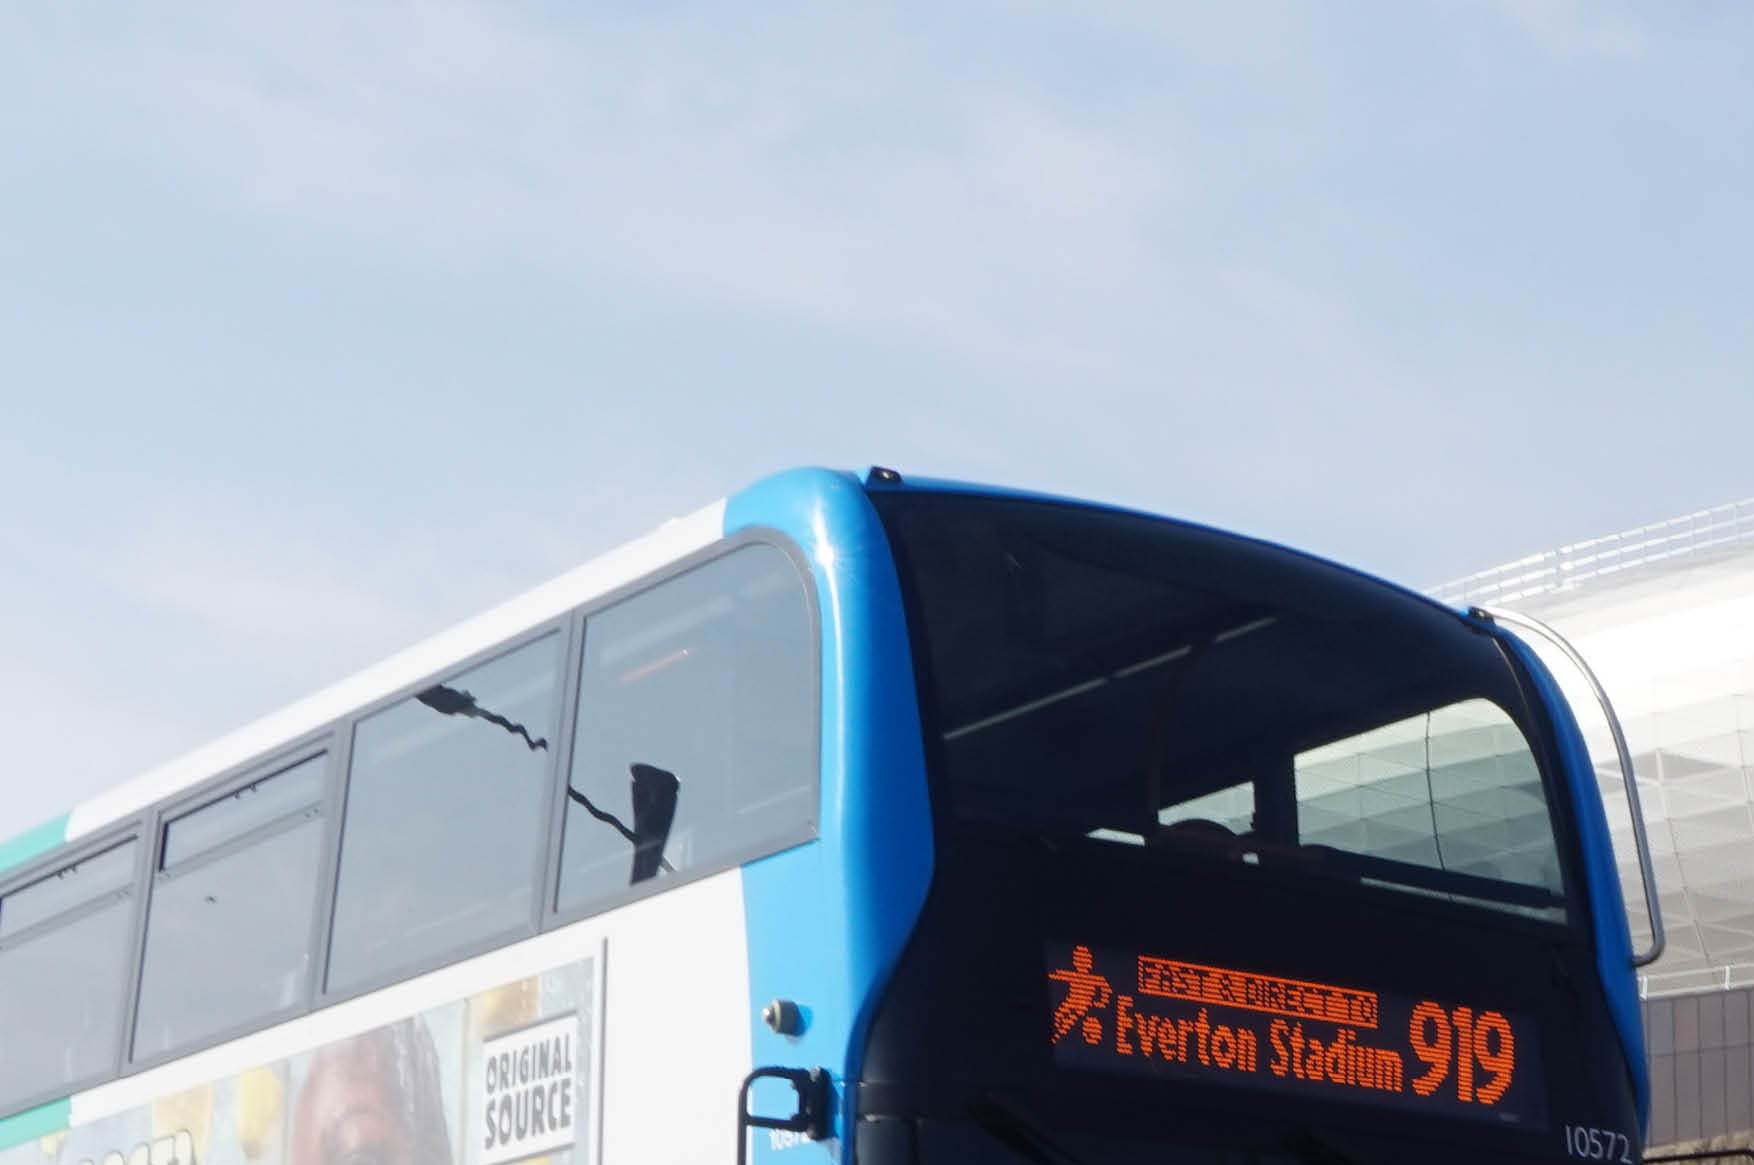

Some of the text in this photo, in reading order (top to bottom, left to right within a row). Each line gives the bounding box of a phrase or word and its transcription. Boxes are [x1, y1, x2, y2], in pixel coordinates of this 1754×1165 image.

[1246, 977, 1333, 1017] DIRECT
[486, 1033, 572, 1094] ORIGINAL
[1116, 995, 1403, 1093] Everton Stadium
[1409, 1000, 1515, 1105] 919
[484, 1077, 571, 1150] SOURCE
[1564, 1124, 1633, 1164] 10572
